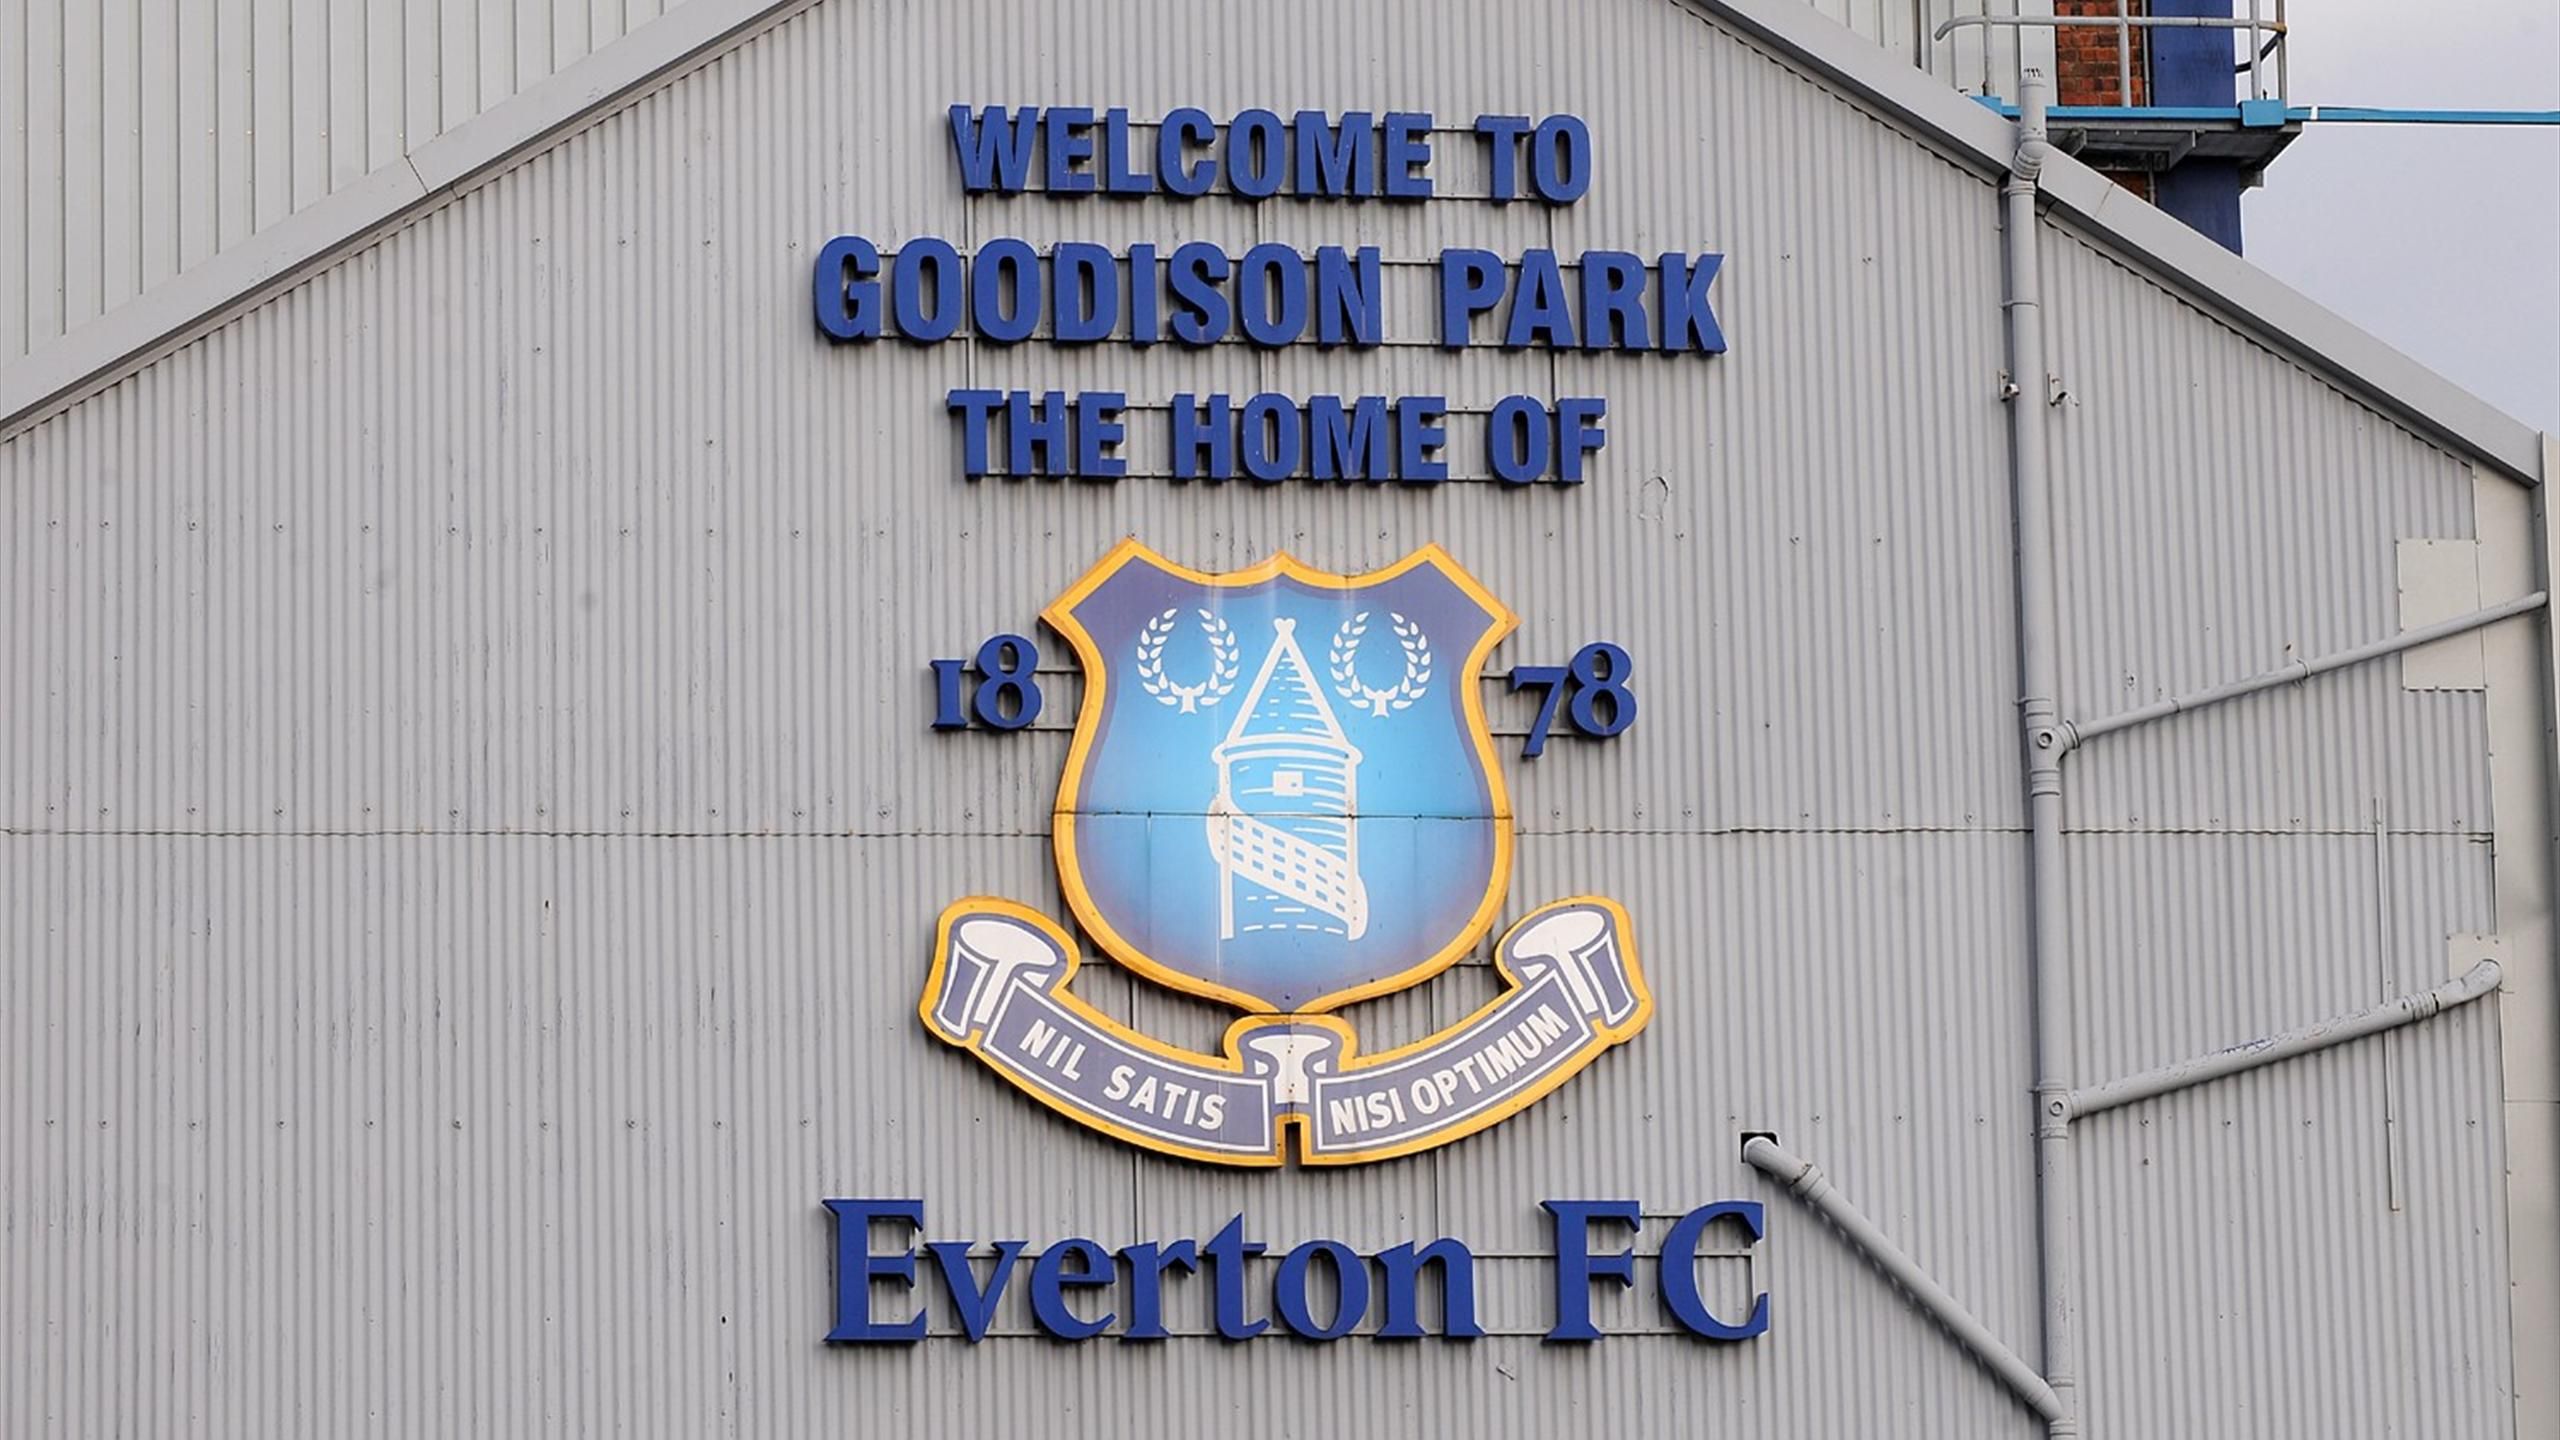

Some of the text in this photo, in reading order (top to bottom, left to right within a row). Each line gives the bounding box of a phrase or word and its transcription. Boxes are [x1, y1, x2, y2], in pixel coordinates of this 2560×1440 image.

[949, 104, 1592, 205] WELCOME TO
[813, 236, 1727, 354] GOODISON PARK
[948, 389, 1607, 485] THE HOME OF
[931, 633, 1042, 732] 18
[1511, 642, 1637, 758] 78
[1018, 1003, 1571, 1135] NIL SATIS NISI OPTIMUM
[823, 1199, 1770, 1345] Everton FC
